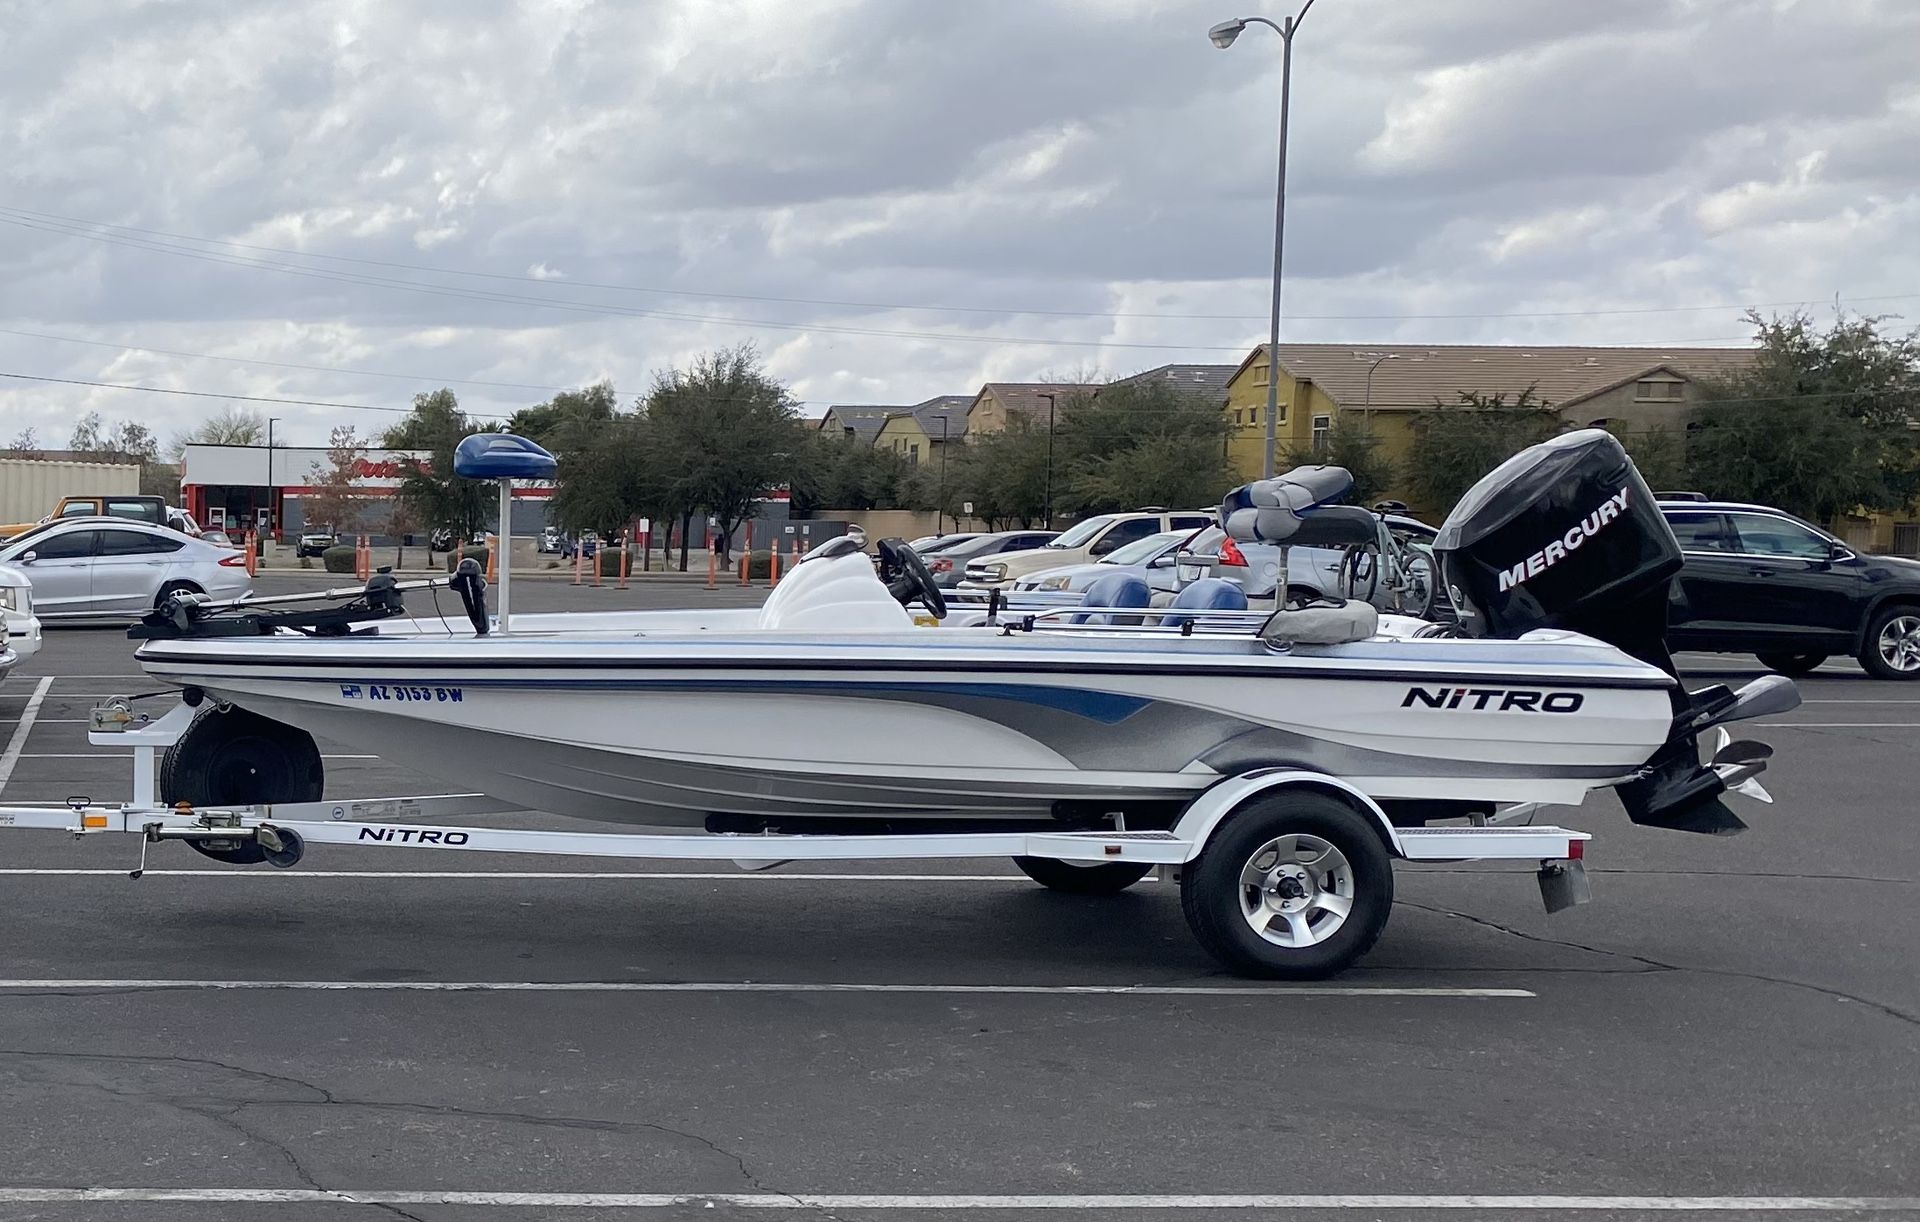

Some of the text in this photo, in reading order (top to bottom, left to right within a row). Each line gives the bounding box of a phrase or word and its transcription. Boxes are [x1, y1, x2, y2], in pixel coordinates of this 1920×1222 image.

[1498, 486, 1629, 592] MERCURY
[370, 686, 391, 700] AZ
[393, 686, 431, 701] 3153
[435, 688, 463, 702] BW
